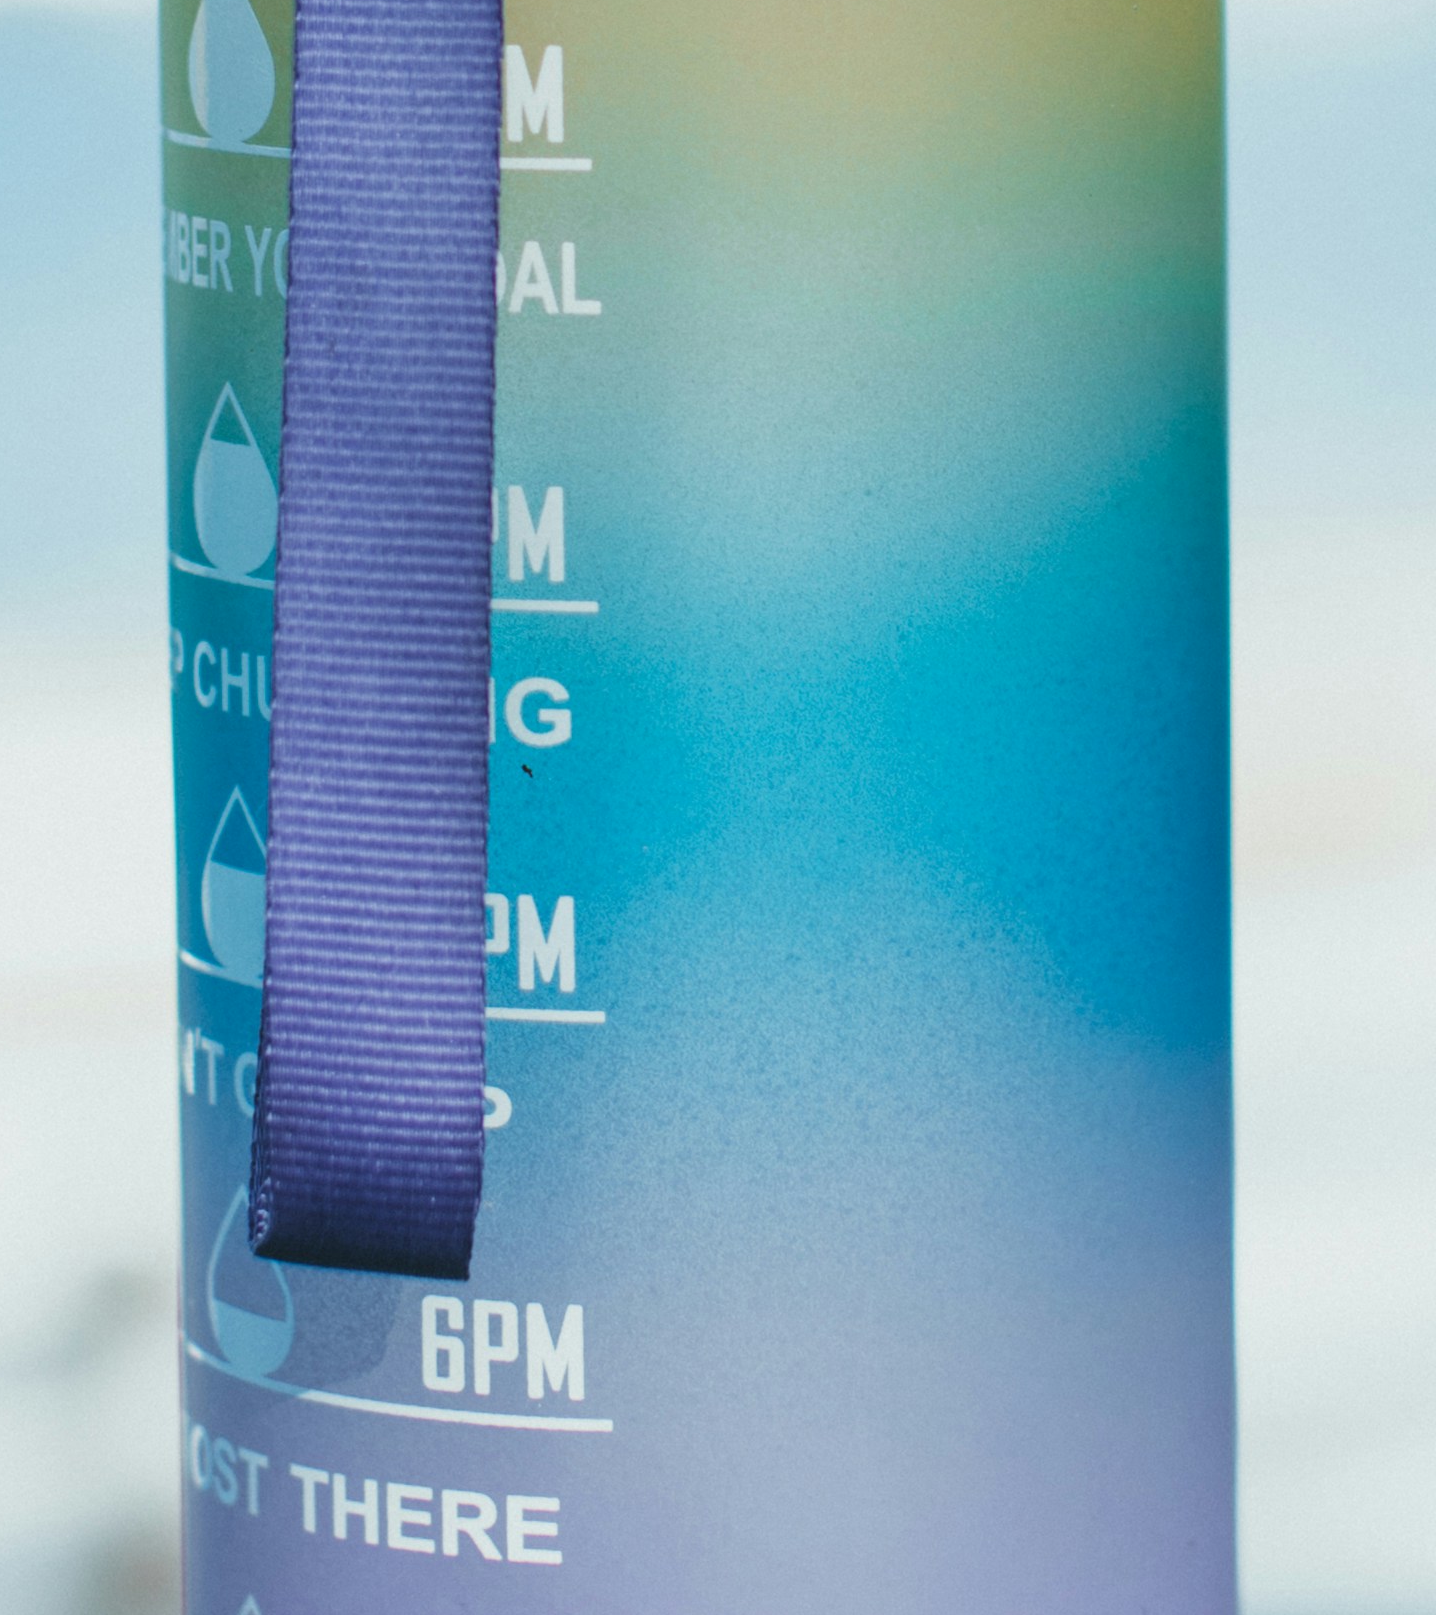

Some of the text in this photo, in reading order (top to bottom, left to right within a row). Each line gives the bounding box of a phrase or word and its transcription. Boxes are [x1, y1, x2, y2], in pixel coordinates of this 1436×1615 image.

[495, 241, 602, 315] AL
[492, 485, 564, 583] M
[489, 677, 572, 747] G
[421, 1295, 585, 1401] 6PM
[290, 1463, 563, 1565] THERE
